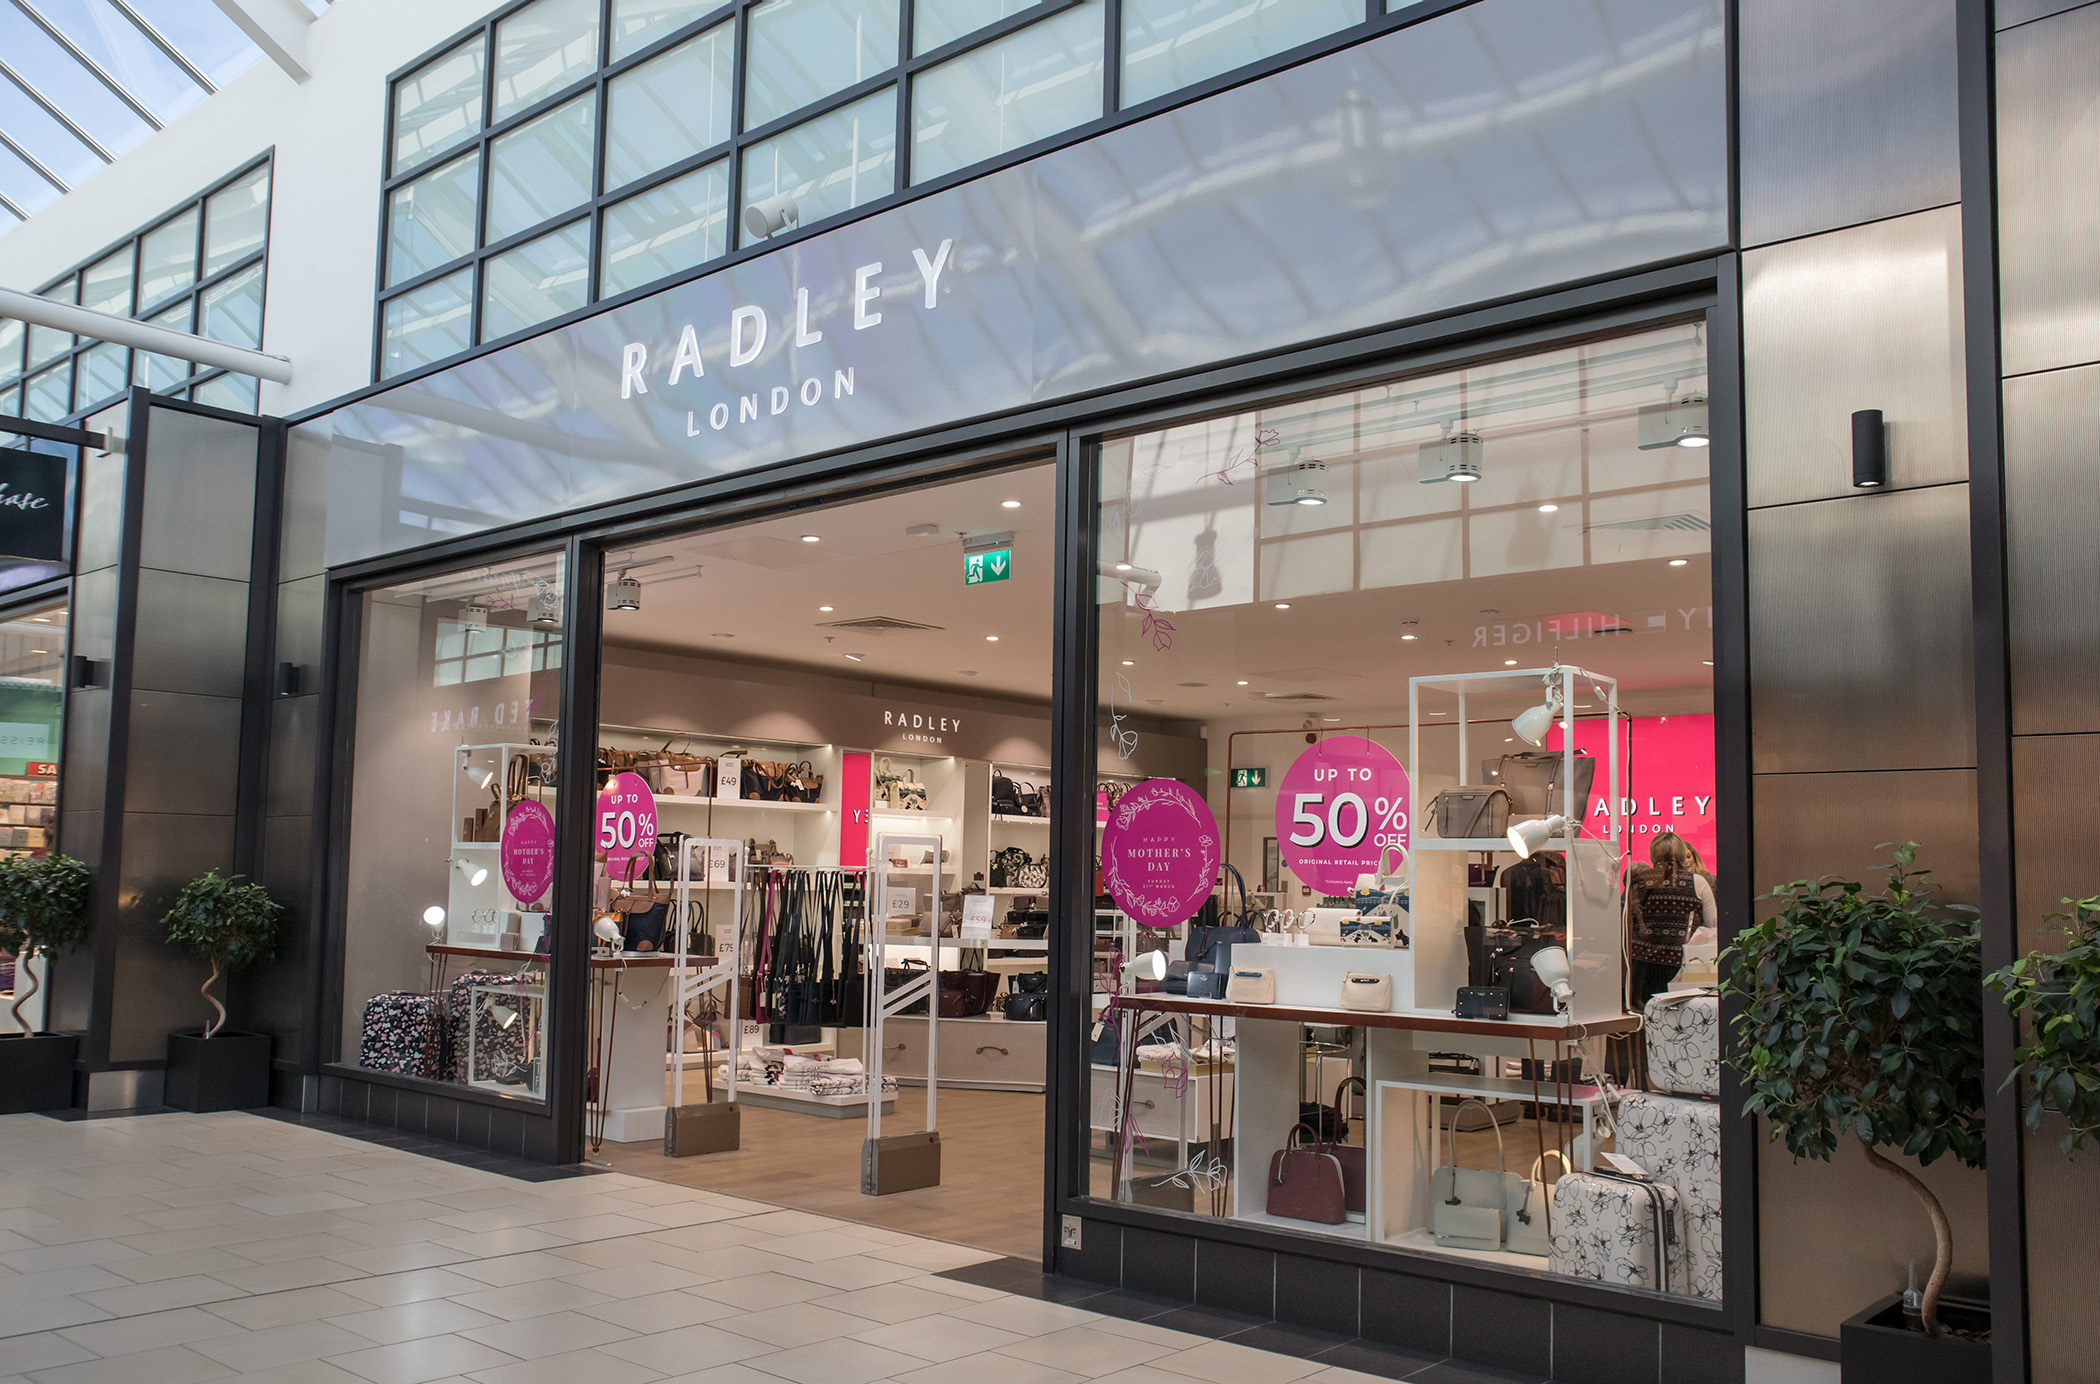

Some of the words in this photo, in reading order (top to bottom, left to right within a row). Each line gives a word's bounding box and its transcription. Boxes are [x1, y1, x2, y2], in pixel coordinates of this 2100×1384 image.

[621, 238, 953, 399] RADLEY
[687, 367, 855, 437] LONDON
[884, 710, 961, 733] RADLEY
[902, 733, 942, 744] LONDON
[1314, 768, 1338, 781] UP
[1347, 768, 1372, 781] TO
[721, 776, 737, 786] £49
[611, 795, 623, 805] UP
[626, 794, 638, 803] TO
[1593, 795, 1712, 817] ADLEY
[1289, 792, 1407, 848] 50%
[600, 811, 654, 849] 50%
[638, 838, 654, 848] OFF
[1374, 833, 1407, 847] OFF
[513, 848, 544, 856] MOTHER'S
[1128, 847, 1191, 858] MOTHER'S
[1148, 861, 1170, 871] DAY
[892, 899, 910, 909] £29
[970, 916, 987, 924] £59
[744, 1025, 759, 1034] £89
